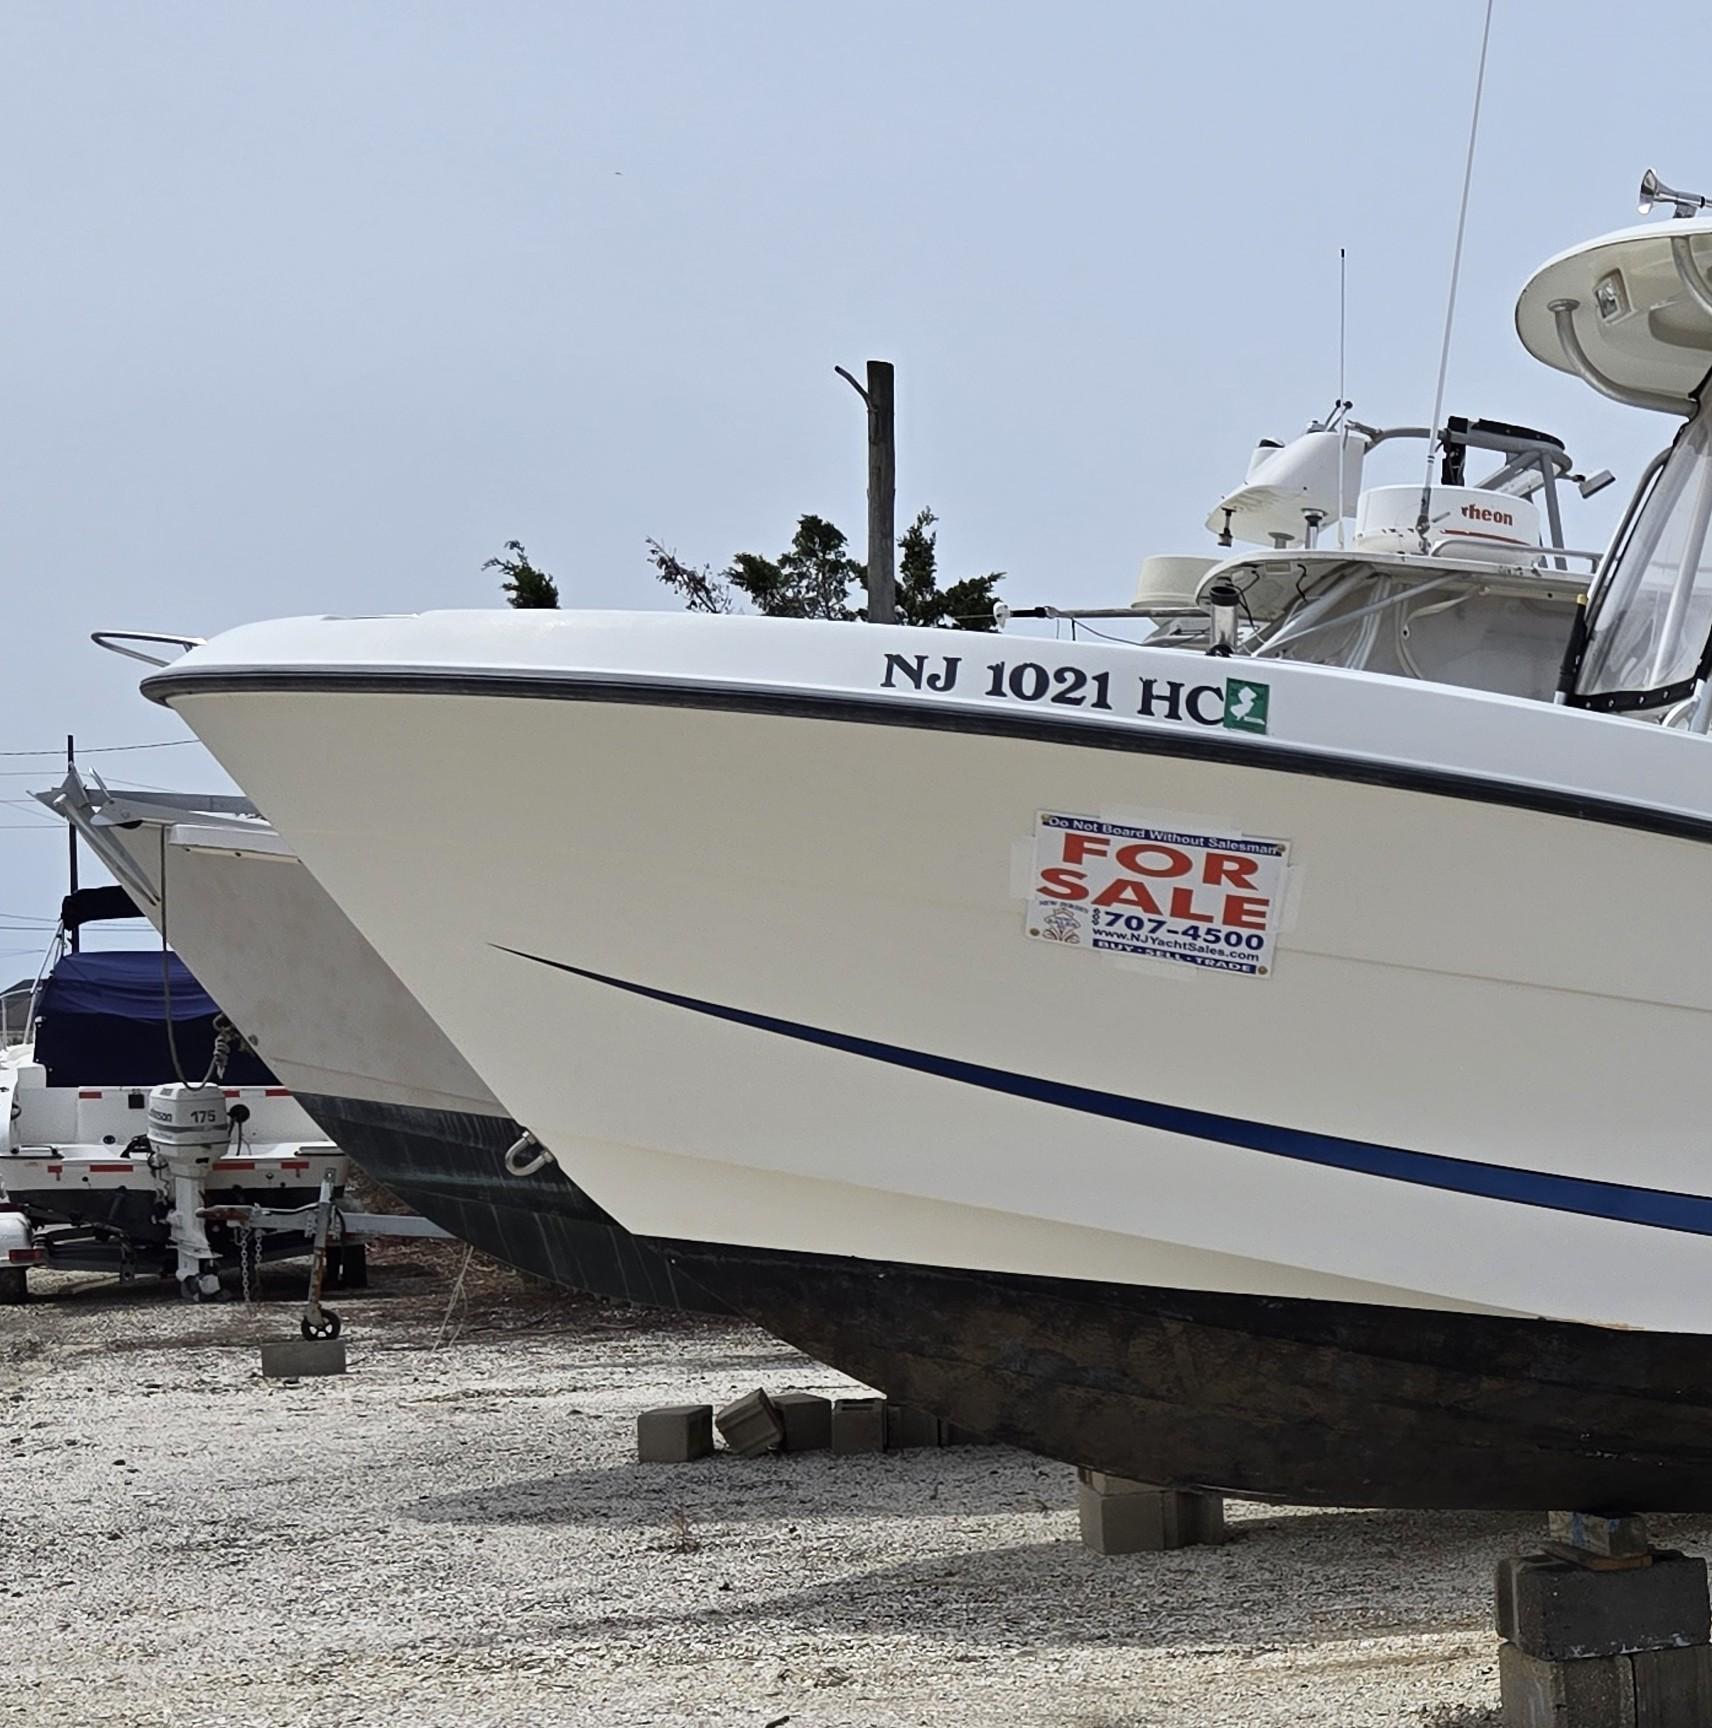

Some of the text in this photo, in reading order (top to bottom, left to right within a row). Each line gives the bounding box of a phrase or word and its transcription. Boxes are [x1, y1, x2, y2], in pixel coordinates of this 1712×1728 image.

[880, 653, 1225, 726] NJ 1021 HC
[1050, 816, 1069, 828] Do
[1073, 820, 1098, 833] Not
[1103, 823, 1146, 839] Board
[1150, 829, 1205, 847] Without
[1062, 832, 1259, 891] FOR
[1036, 867, 1270, 931] SALE
[1092, 927, 1260, 963] www.NJYachtSales.com
[1104, 911, 1264, 951] 707-4500
[1097, 940, 1251, 973] BUY SELL TRADE
[190, 1109, 217, 1123] 175
